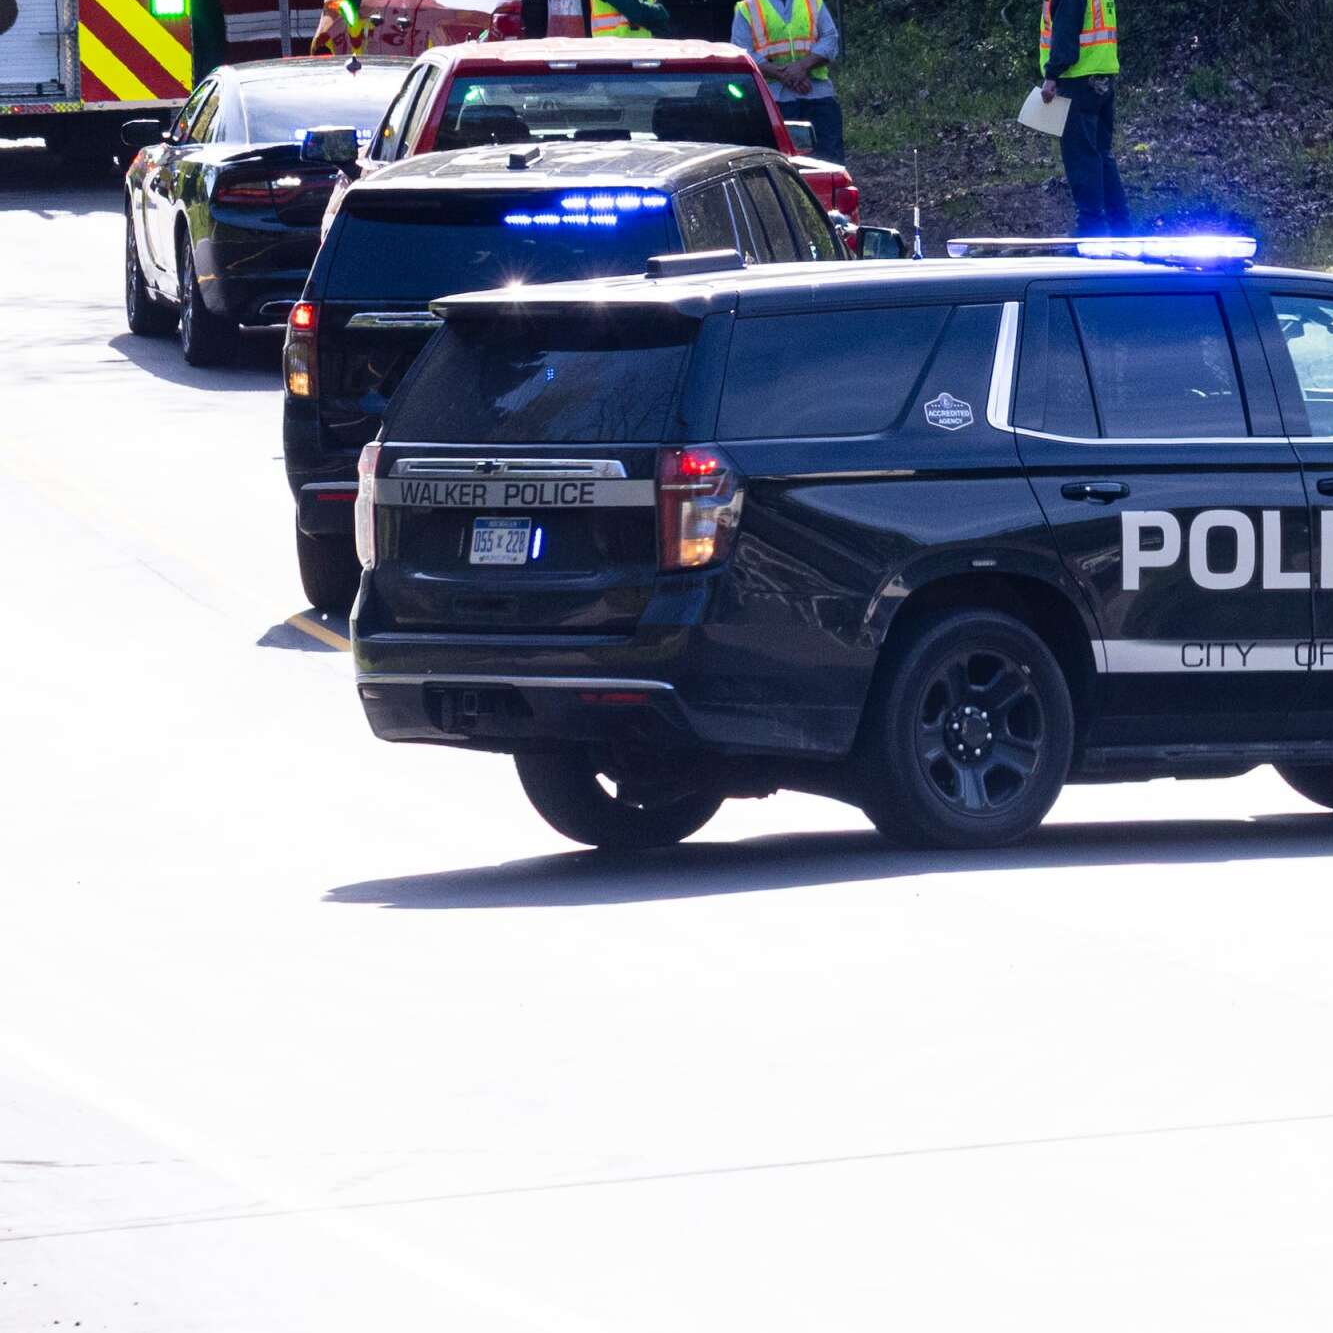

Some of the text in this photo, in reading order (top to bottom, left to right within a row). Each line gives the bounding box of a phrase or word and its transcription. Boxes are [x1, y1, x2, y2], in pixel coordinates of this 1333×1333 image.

[400, 482, 596, 506] WALKER POLICE
[474, 530, 494, 553] 055
[506, 530, 526, 553] 228
[1181, 642, 1257, 667] CITY
